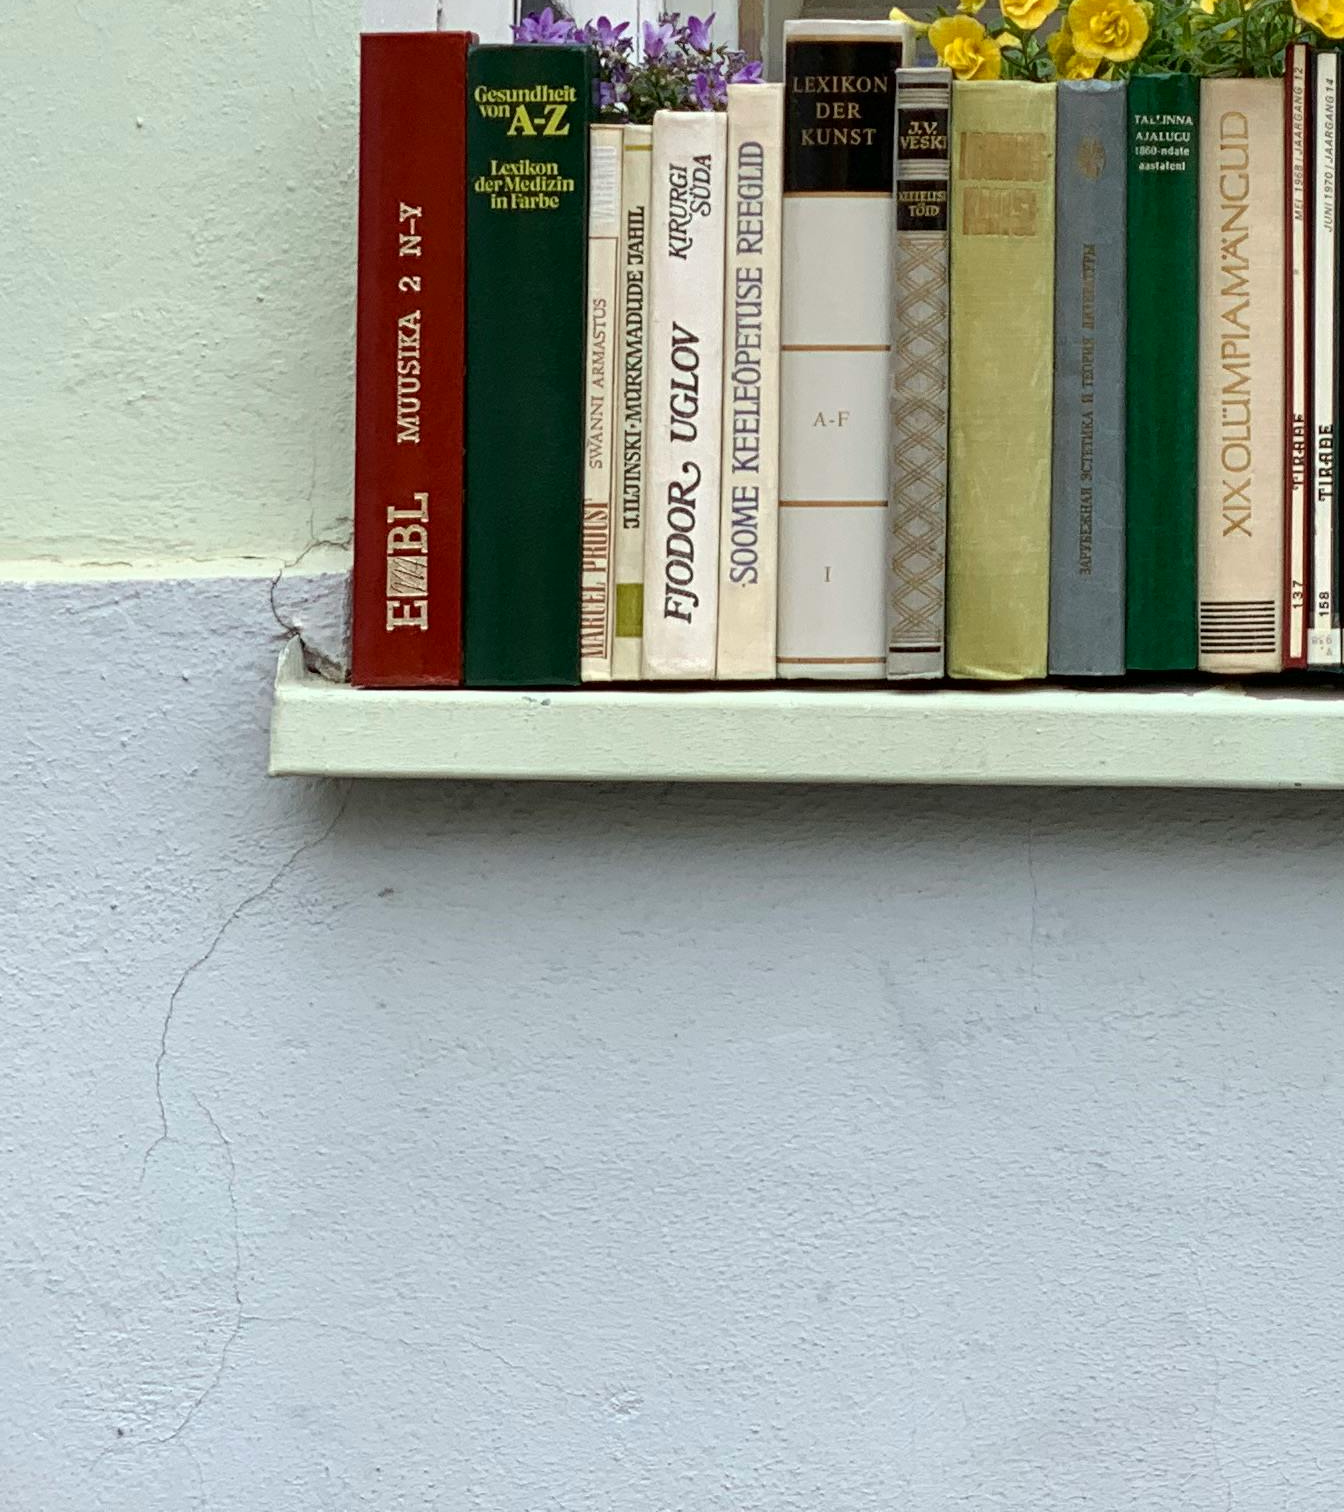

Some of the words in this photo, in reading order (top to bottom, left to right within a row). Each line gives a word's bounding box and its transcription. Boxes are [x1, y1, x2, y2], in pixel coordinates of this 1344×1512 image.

[474, 85, 577, 104] Gesundheit
[792, 76, 889, 94] LEXIKON
[506, 104, 571, 138] A-Z
[815, 102, 862, 120] DER
[1134, 114, 1194, 126] TALLINNA
[801, 128, 878, 146] KUNST
[1135, 131, 1191, 143] AJALUGU
[490, 159, 559, 177] Lexikon
[503, 176, 575, 193] Medizin
[690, 153, 713, 217] SÜDA
[1324, 172, 1334, 200] 1970
[510, 193, 560, 210] Farbe
[668, 163, 692, 262] KIRURGI
[737, 140, 765, 256] REEGLID
[1323, 202, 1333, 234] JUNI
[627, 205, 646, 265] JAHIL
[1219, 109, 1252, 474] OLÜMPIAMÄNGUD
[590, 297, 607, 389] ARMASTUS
[397, 310, 422, 444] MUUSIKA
[670, 320, 700, 443] UGLOV
[813, 411, 850, 428] A-F
[1318, 424, 1334, 502] TIRADE
[1221, 476, 1253, 539] XIX
[664, 461, 702, 625] FJODOR
[729, 485, 760, 585] SOOME
[1078, 488, 1094, 576] ЗАРУБЕЖНАЯ
